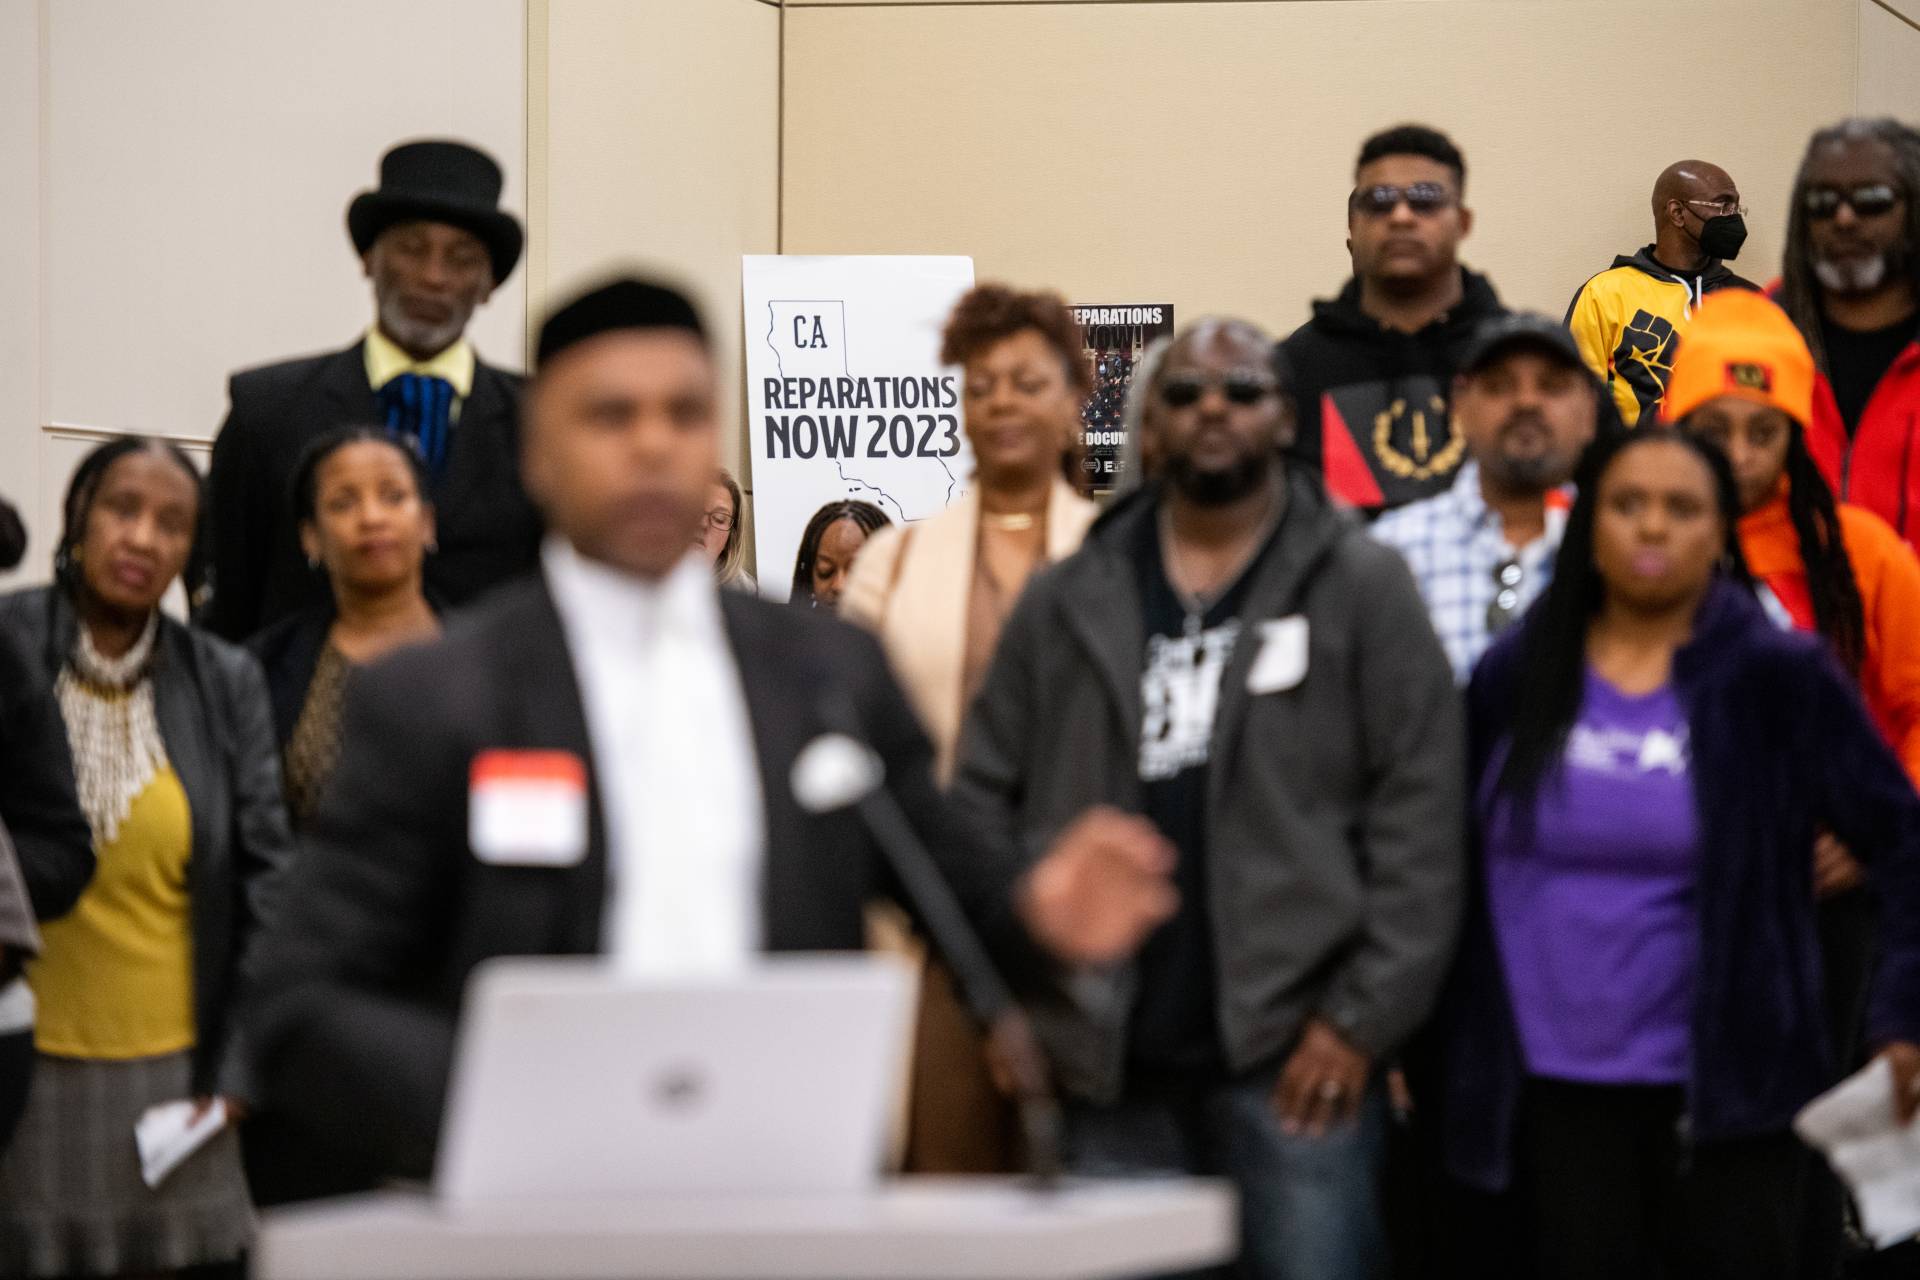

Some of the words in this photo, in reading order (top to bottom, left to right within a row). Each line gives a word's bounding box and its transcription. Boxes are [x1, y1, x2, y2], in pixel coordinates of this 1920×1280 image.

[793, 315, 828, 349] CA
[1073, 307, 1163, 325] EPARATIONS
[763, 376, 958, 409] REPARATIONS
[764, 414, 859, 460] NOW
[866, 413, 961, 459] 2023
[1085, 431, 1129, 446] DOCUM
